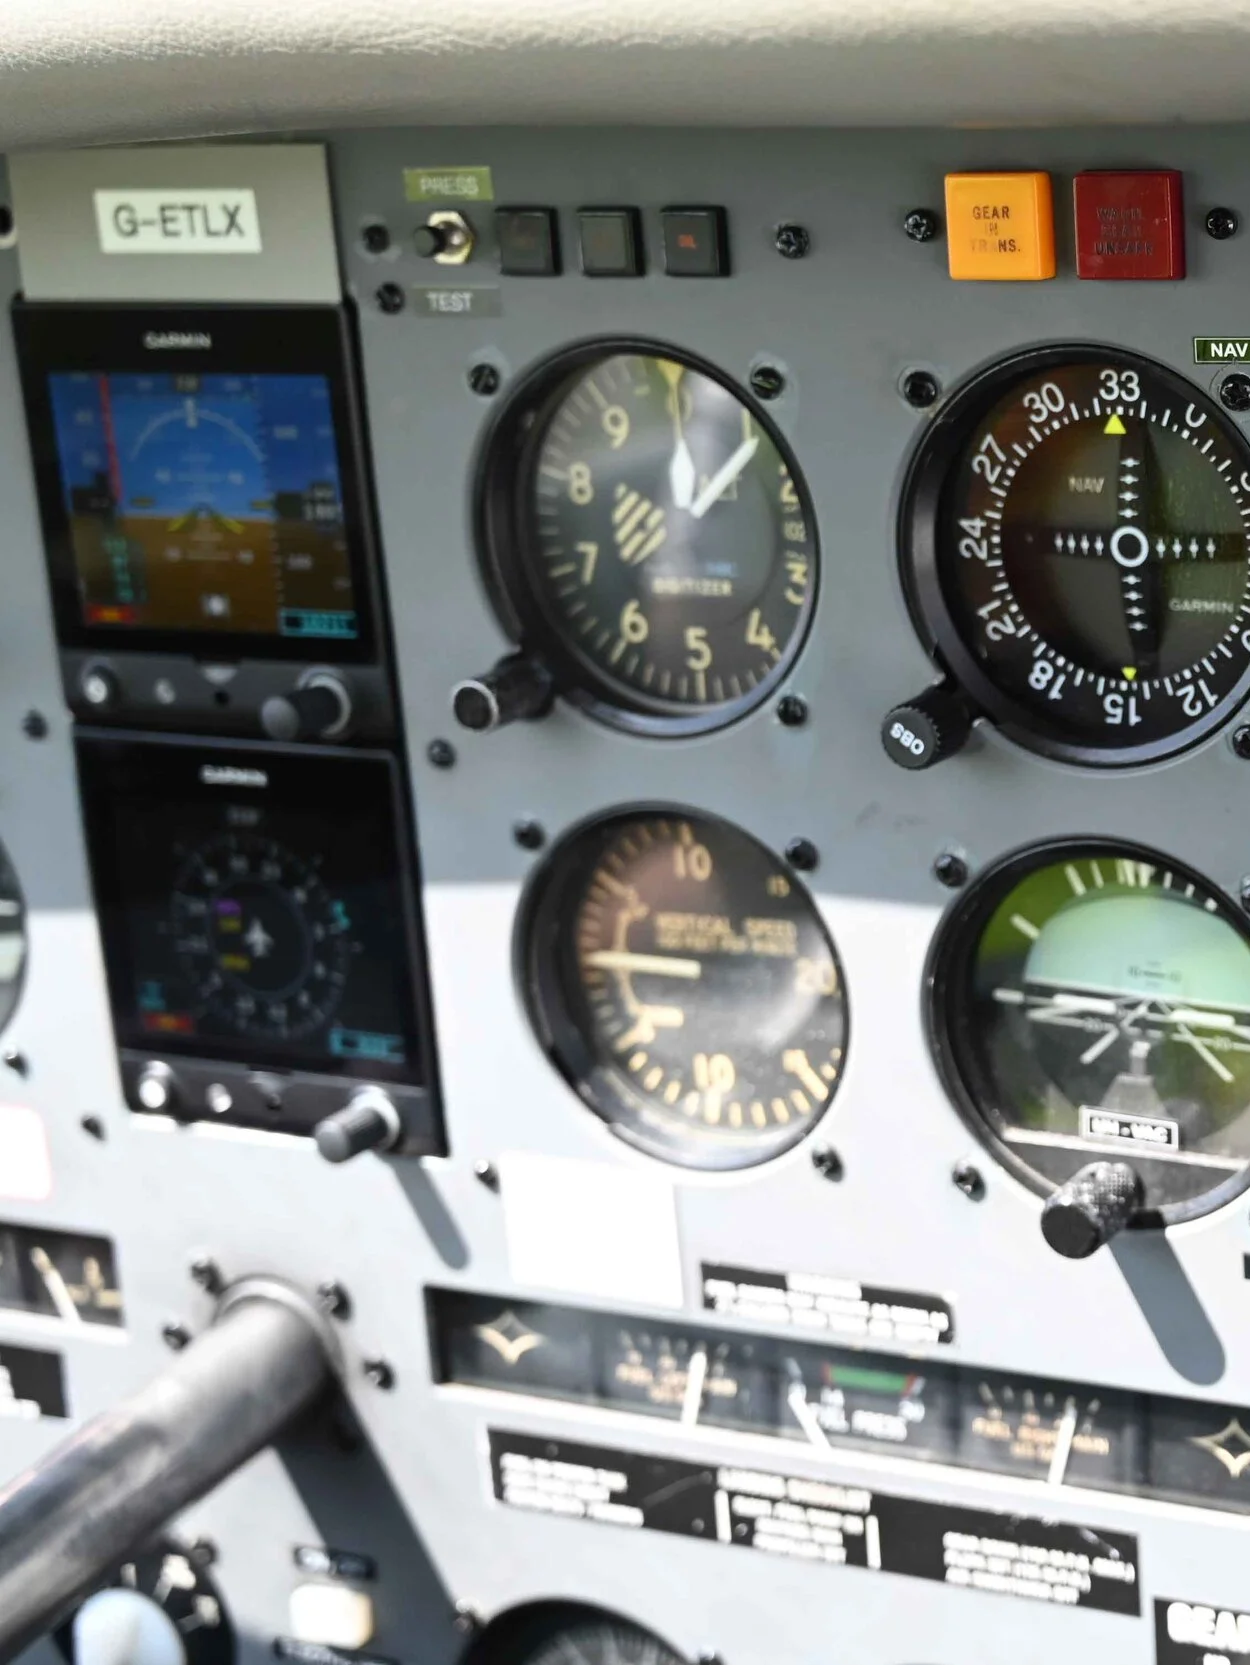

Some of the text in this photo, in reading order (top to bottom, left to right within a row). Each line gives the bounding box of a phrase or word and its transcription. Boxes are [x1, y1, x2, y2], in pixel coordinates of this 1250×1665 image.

[419, 176, 480, 196] PRESS
[112, 203, 245, 238] G-ETLX
[972, 206, 1010, 220] GEAR
[427, 292, 473, 312] TEST
[1210, 342, 1248, 358] NAV
[1024, 383, 1065, 423] 30
[1100, 370, 1140, 402] 33
[603, 405, 629, 449] 9
[972, 434, 1006, 482] 27
[569, 461, 594, 505] 8
[1068, 477, 1104, 493] NAV
[959, 517, 986, 560] 24
[576, 542, 598, 585] 7
[620, 600, 648, 643] 6
[977, 599, 1016, 641] 21
[1169, 598, 1234, 613] GARMIN
[745, 608, 774, 650] 4
[684, 626, 712, 671] 5
[1028, 660, 1064, 700] 18
[1182, 679, 1218, 717] 12
[1104, 696, 1141, 726] 15
[889, 723, 924, 755] OBS
[673, 844, 713, 882] 10
